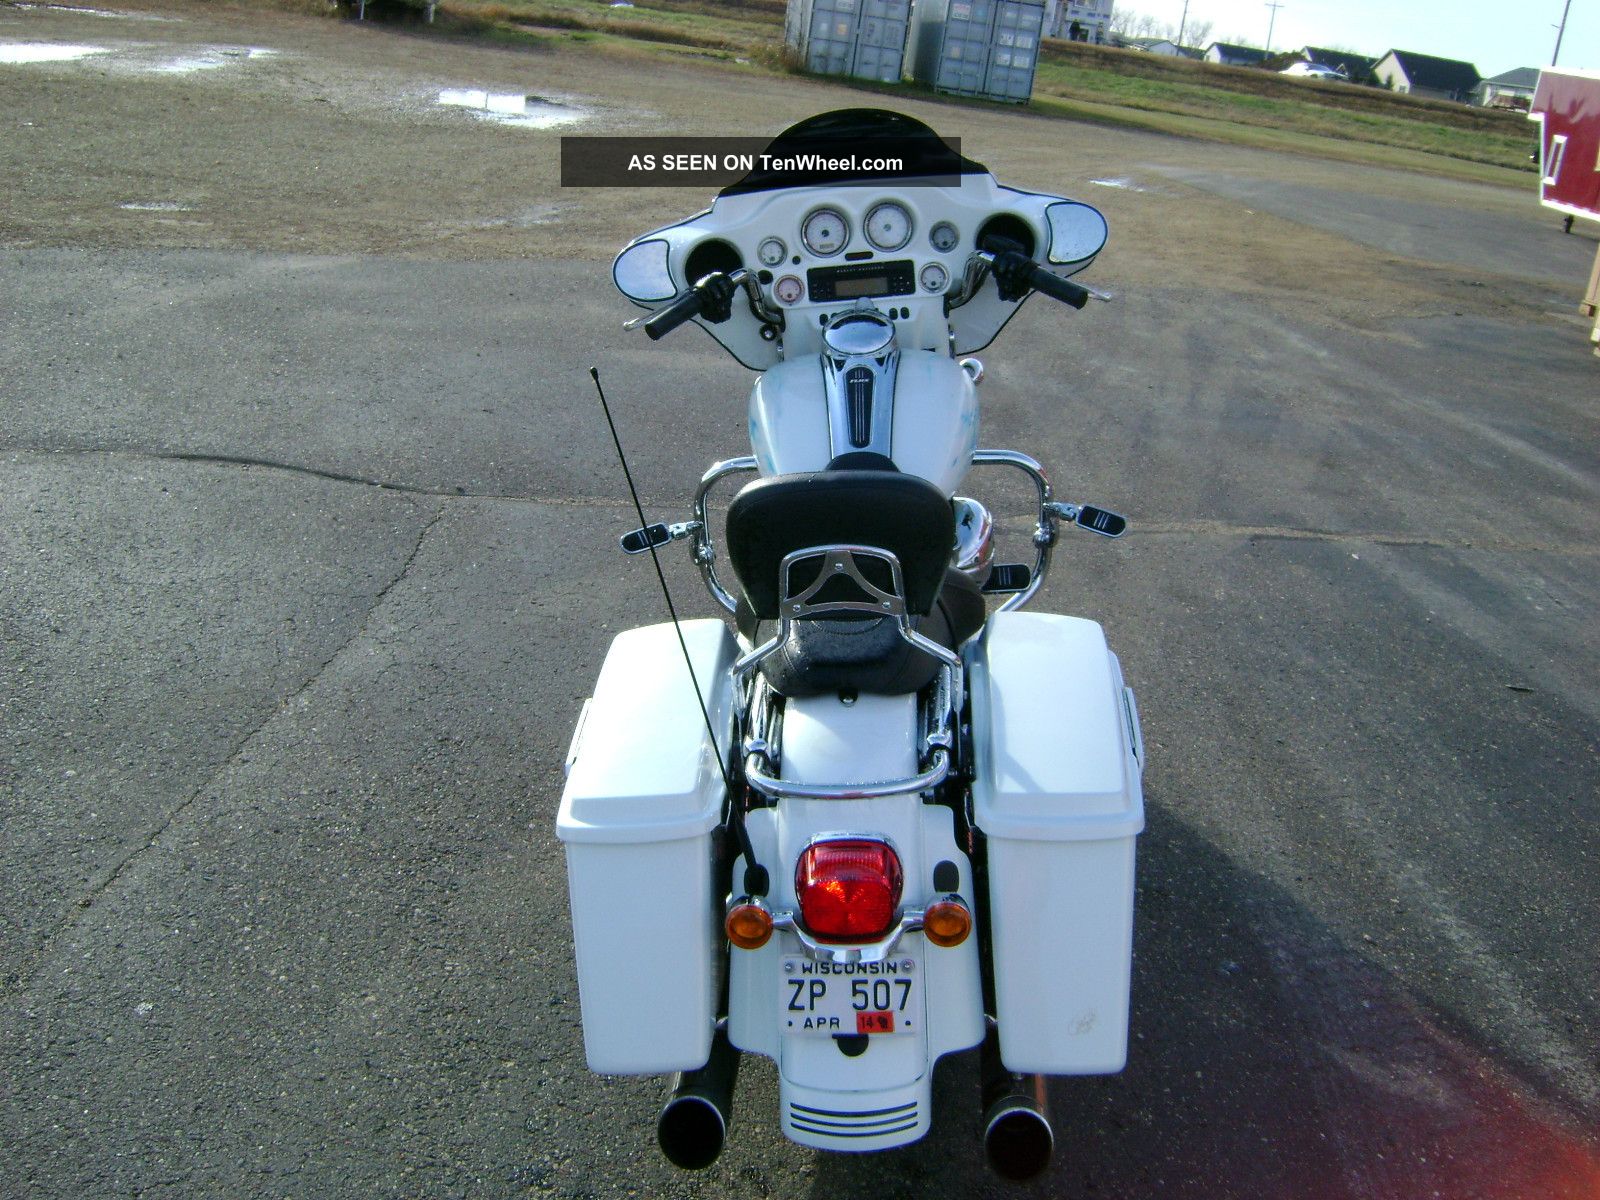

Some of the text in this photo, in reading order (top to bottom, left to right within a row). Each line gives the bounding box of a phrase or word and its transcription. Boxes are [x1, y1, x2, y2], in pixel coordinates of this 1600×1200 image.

[802, 961, 898, 975] WISCONSIN
[788, 979, 912, 1011] ZP 507
[803, 1016, 840, 1030] APR
